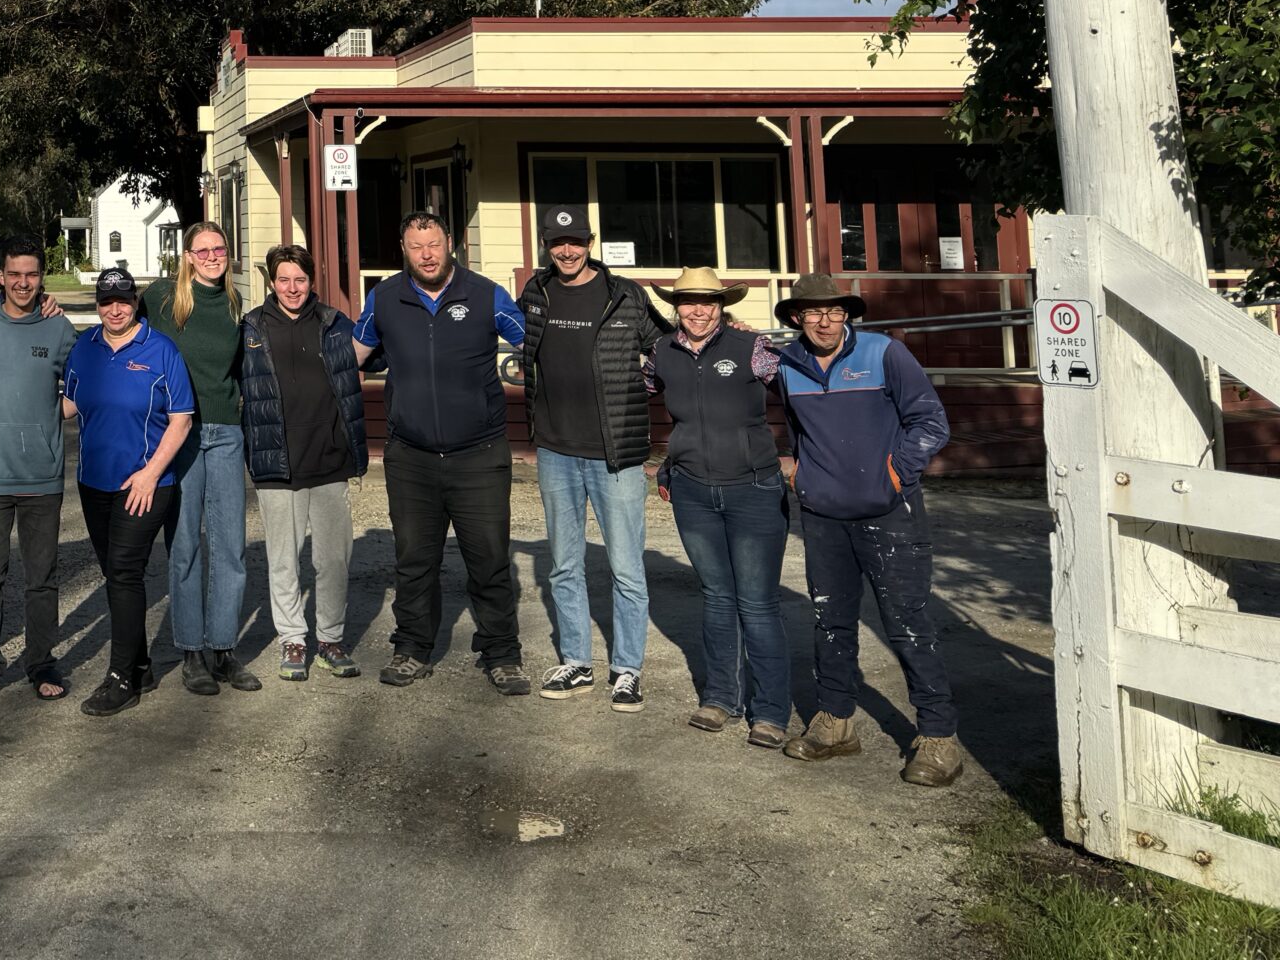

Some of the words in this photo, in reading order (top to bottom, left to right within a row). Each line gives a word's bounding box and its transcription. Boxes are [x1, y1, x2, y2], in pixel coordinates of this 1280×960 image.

[1057, 312, 1072, 326] 10
[1046, 337, 1087, 347] SHARED
[1054, 348, 1081, 358] ZONE
